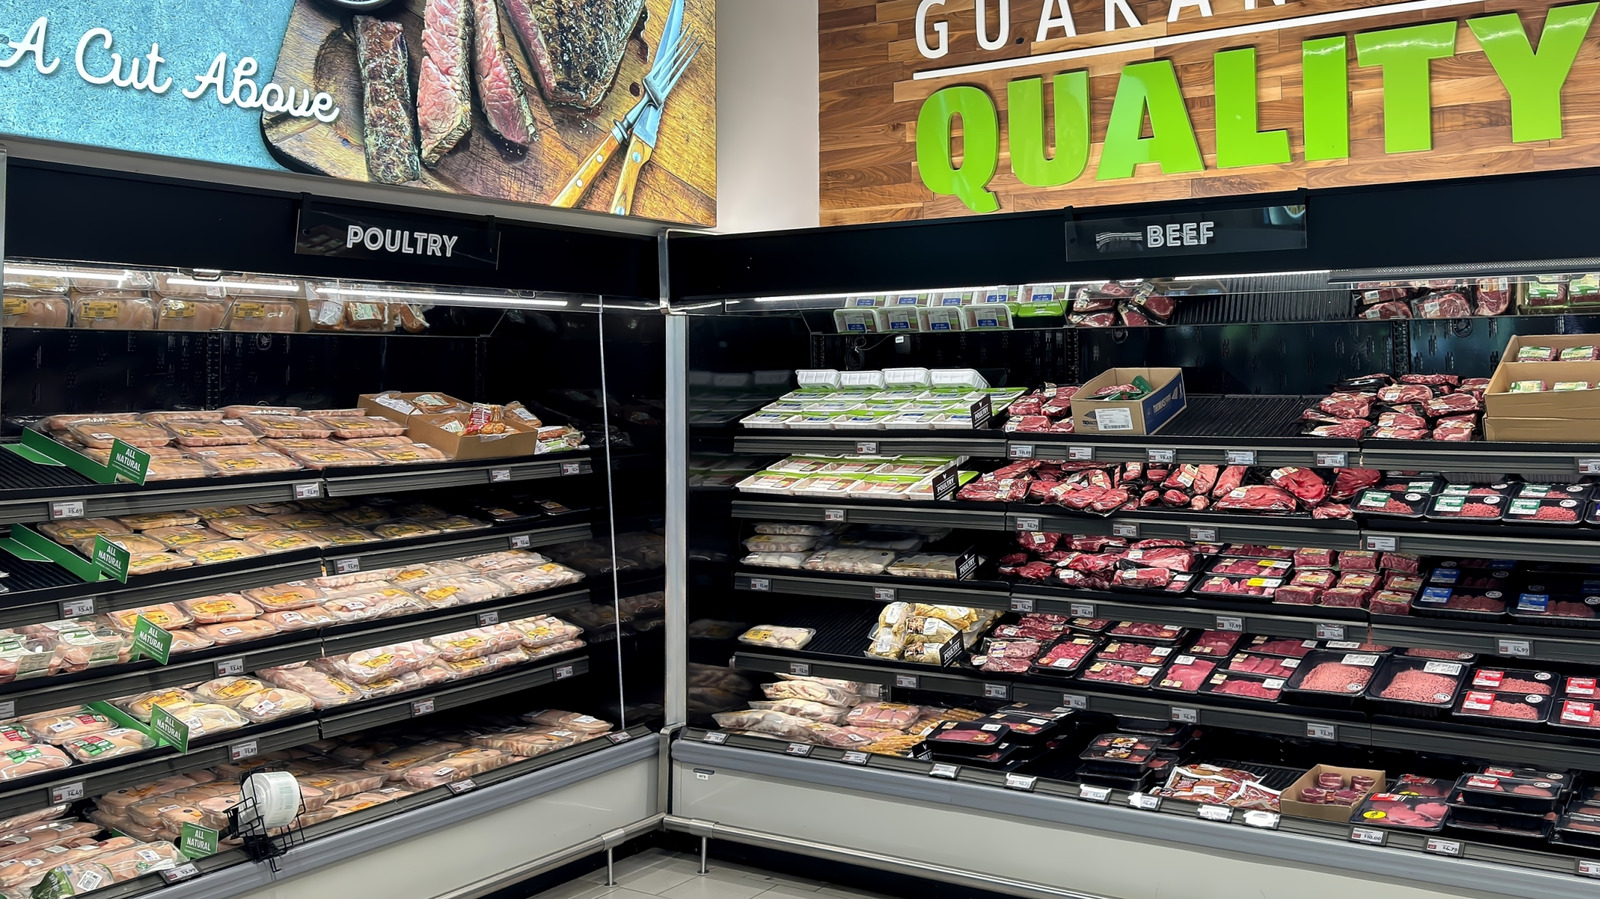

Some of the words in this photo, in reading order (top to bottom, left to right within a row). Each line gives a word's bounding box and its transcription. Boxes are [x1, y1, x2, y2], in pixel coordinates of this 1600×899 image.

[0, 16, 60, 75] A
[75, 27, 172, 94] Cut
[182, 52, 340, 123] Above
[915, 2, 1600, 213] QUALITY
[346, 224, 458, 258] POULTRY
[1146, 221, 1215, 248] BEEF
[974, 406, 990, 421] POULTRY
[115, 452, 141, 472] NATURAL
[125, 448, 136, 459] ALL
[936, 478, 955, 494] POULTRY
[98, 549, 122, 570] NATURAL
[106, 545, 116, 557] ALL
[959, 557, 976, 574] POULTRY
[139, 630, 163, 652] NATURAL
[147, 626, 159, 639] ALL
[943, 642, 960, 659] POULTRY
[156, 718, 181, 741] NATURAL
[165, 716, 175, 728] ALL
[194, 829, 204, 840] ALL
[186, 836, 211, 852] NATURAL
